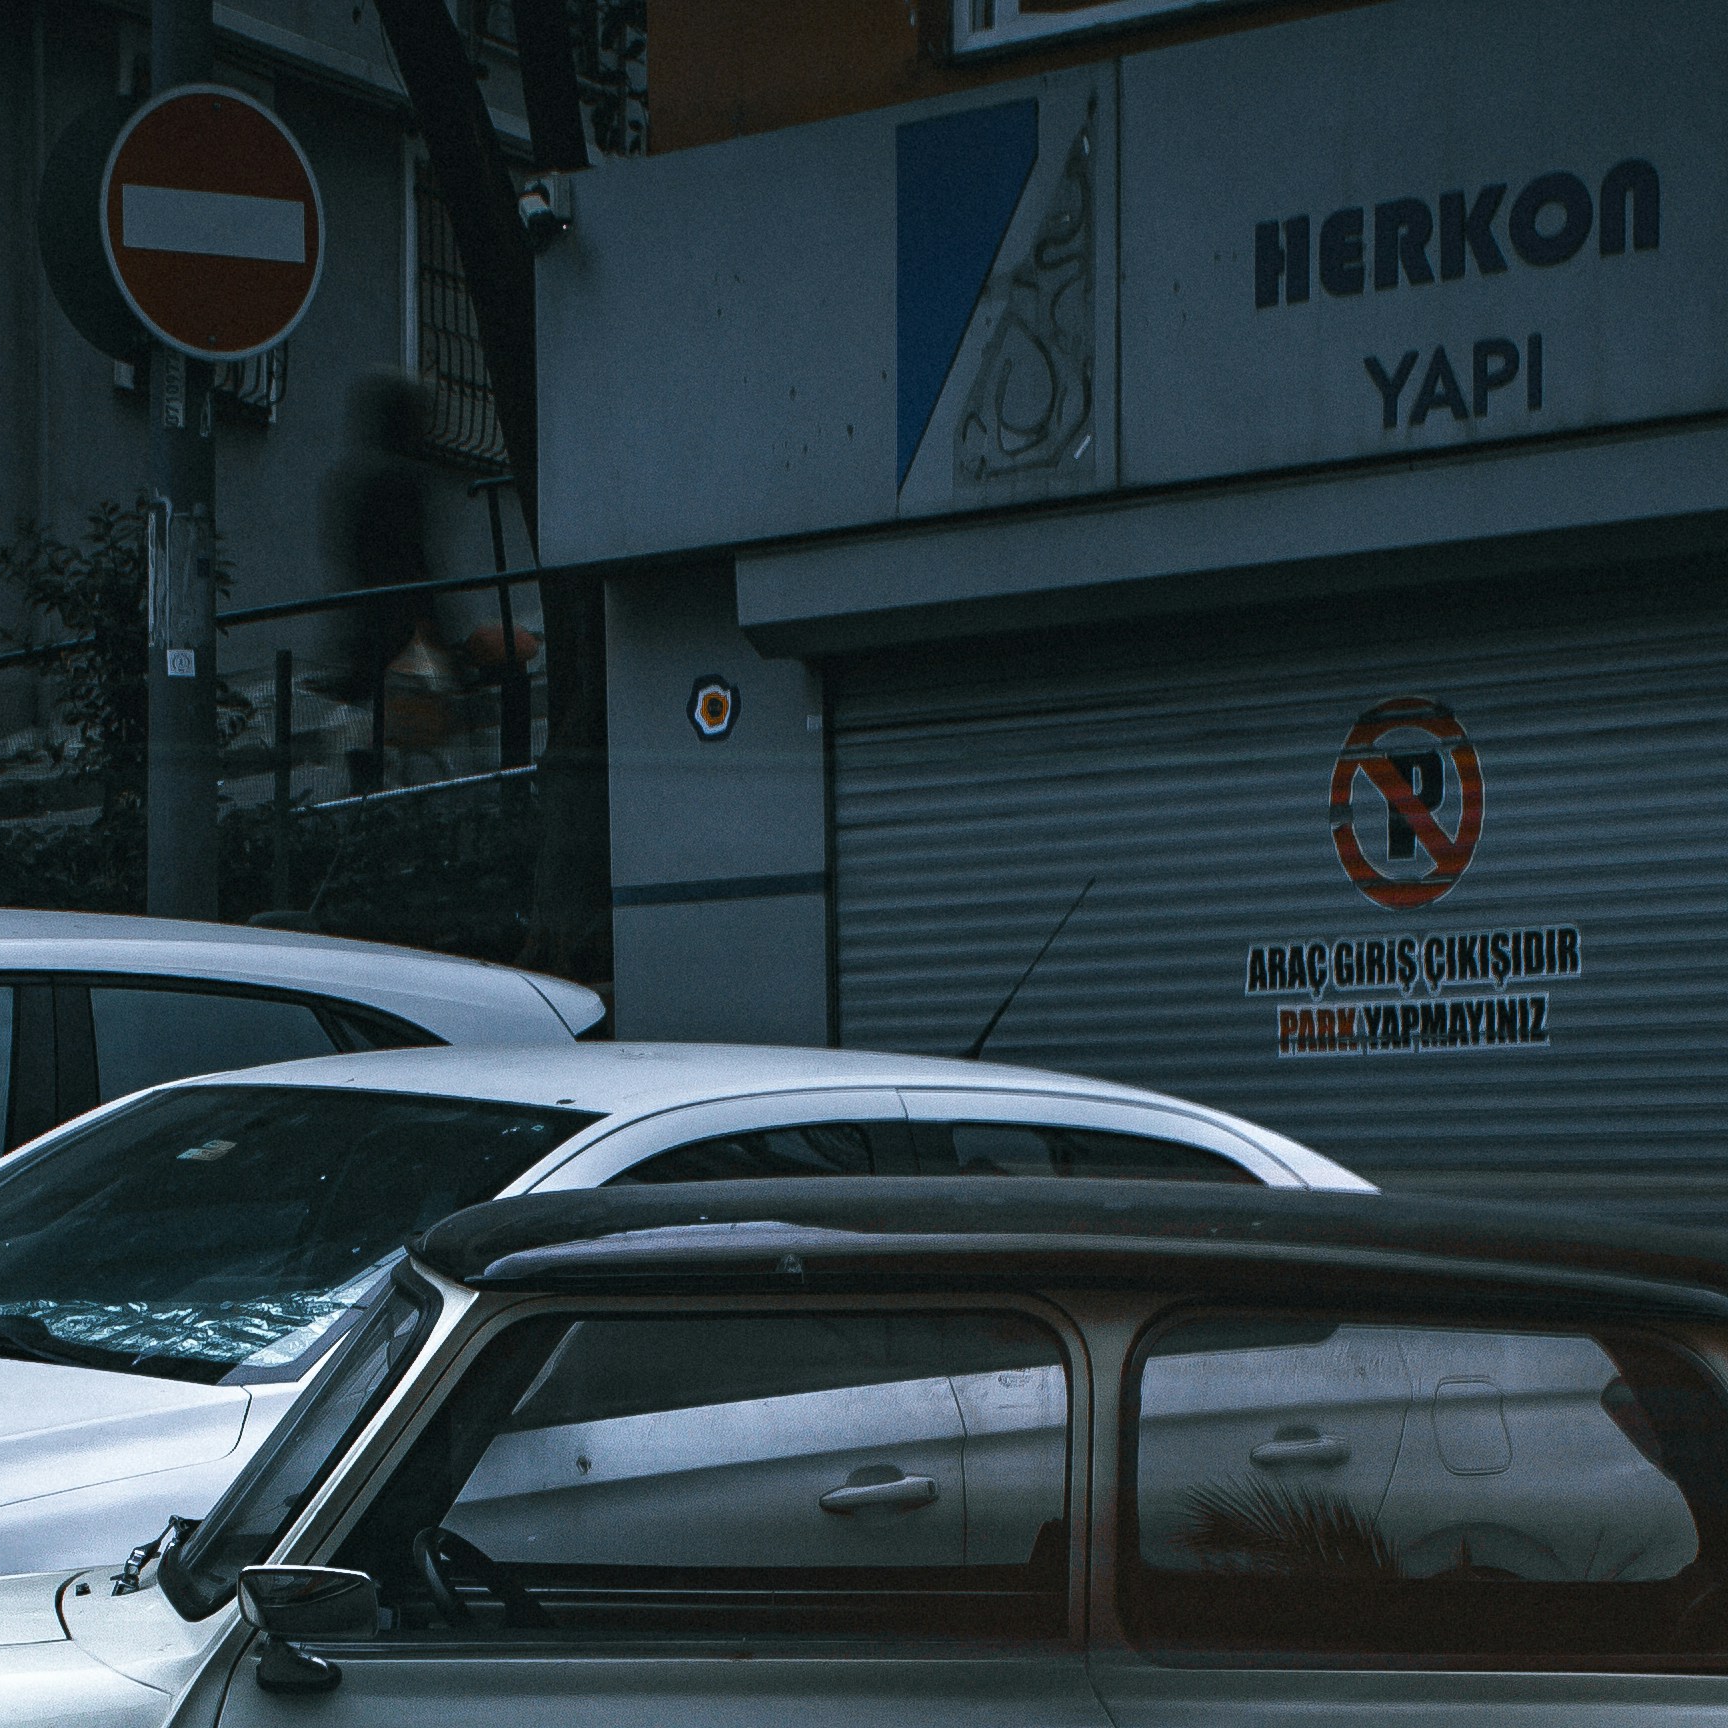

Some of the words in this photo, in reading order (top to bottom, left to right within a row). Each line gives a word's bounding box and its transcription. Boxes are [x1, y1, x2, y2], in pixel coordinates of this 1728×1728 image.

[1254, 156, 1661, 310] HERKON
[1363, 331, 1543, 431] YAPI
[1247, 942, 1328, 997] ARAÇ
[1332, 938, 1418, 994] GİRİŞ
[1423, 927, 1580, 992] ÇIKIŞIDIR
[1279, 1007, 1359, 1053] PARK
[1362, 996, 1548, 1049] YAPMAYINIZ
